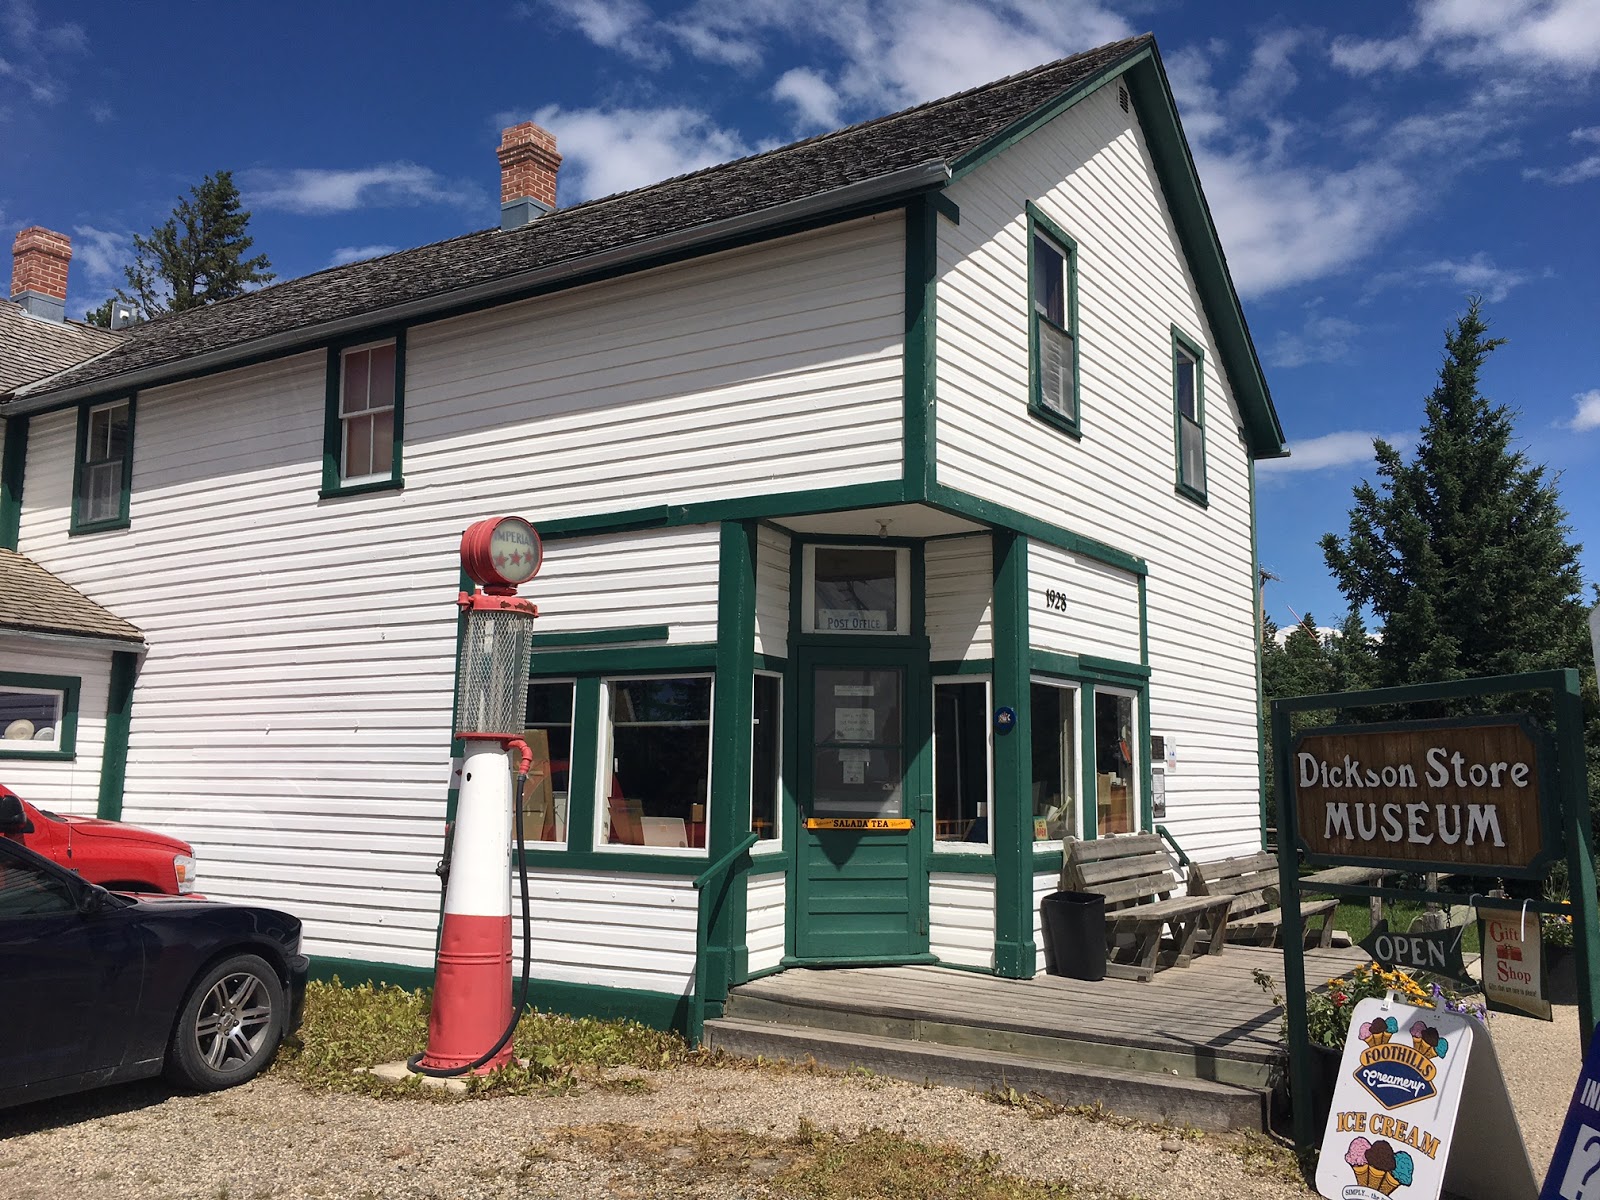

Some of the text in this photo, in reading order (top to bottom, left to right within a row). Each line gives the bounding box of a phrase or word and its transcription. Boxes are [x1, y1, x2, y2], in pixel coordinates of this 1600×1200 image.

[1045, 588, 1067, 612] 1928
[827, 617, 880, 629] POST OFFICE
[1297, 747, 1529, 788] Dickson Store
[871, 819, 889, 828] TEA
[1323, 801, 1506, 848] MUSEUM
[1489, 921, 1519, 943] Gift
[1375, 934, 1446, 968] OPEN
[1497, 960, 1531, 984] Shop
[1365, 1045, 1433, 1078] FOOTHILLS
[1362, 1069, 1426, 1097] Creamery
[1336, 1111, 1441, 1160] ICE CREAM
